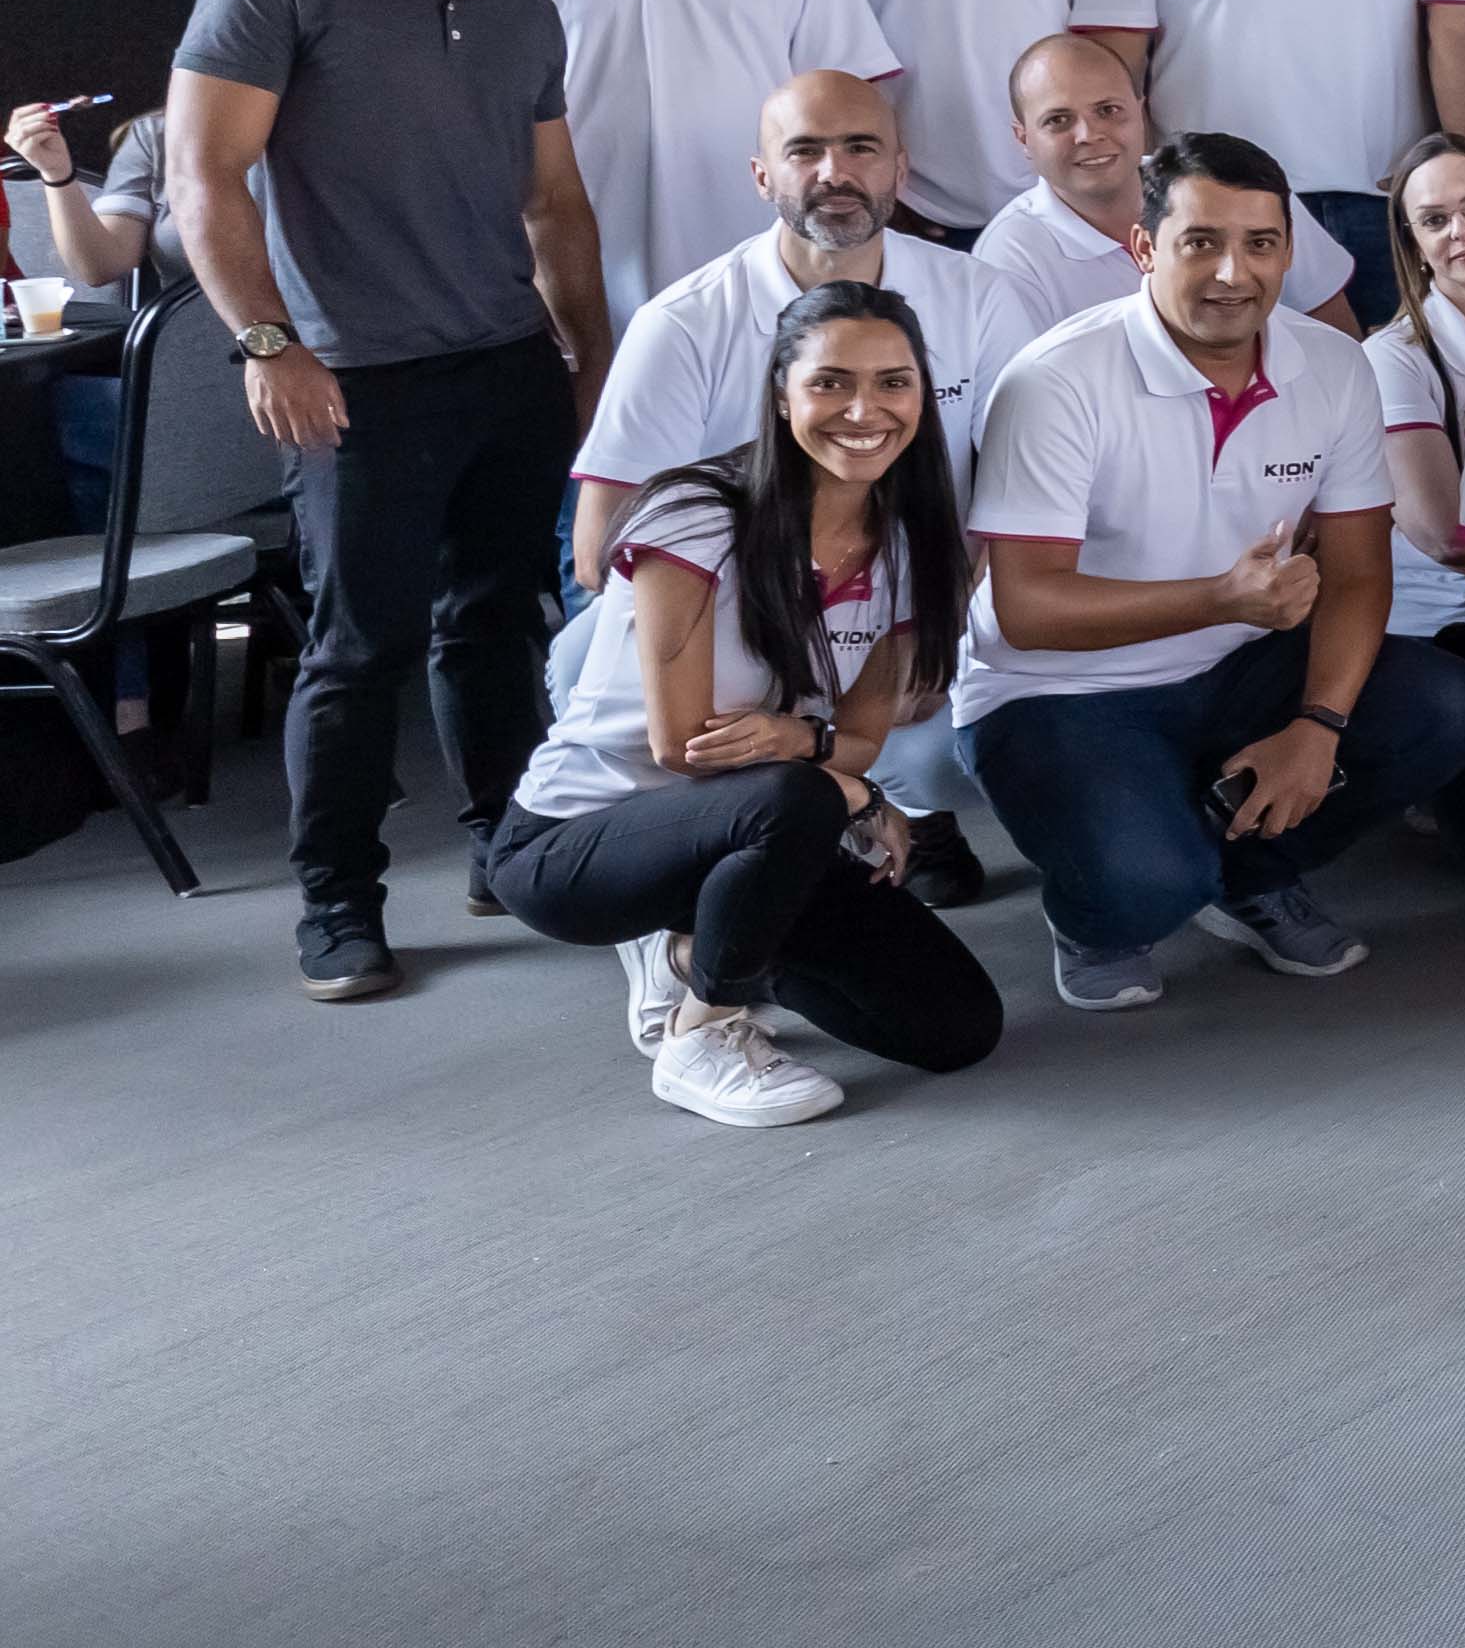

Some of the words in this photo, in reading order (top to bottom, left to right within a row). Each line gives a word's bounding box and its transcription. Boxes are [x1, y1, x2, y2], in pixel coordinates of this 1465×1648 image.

[934, 385, 962, 400] ON
[1264, 461, 1314, 477] KION
[829, 631, 876, 644] KION
